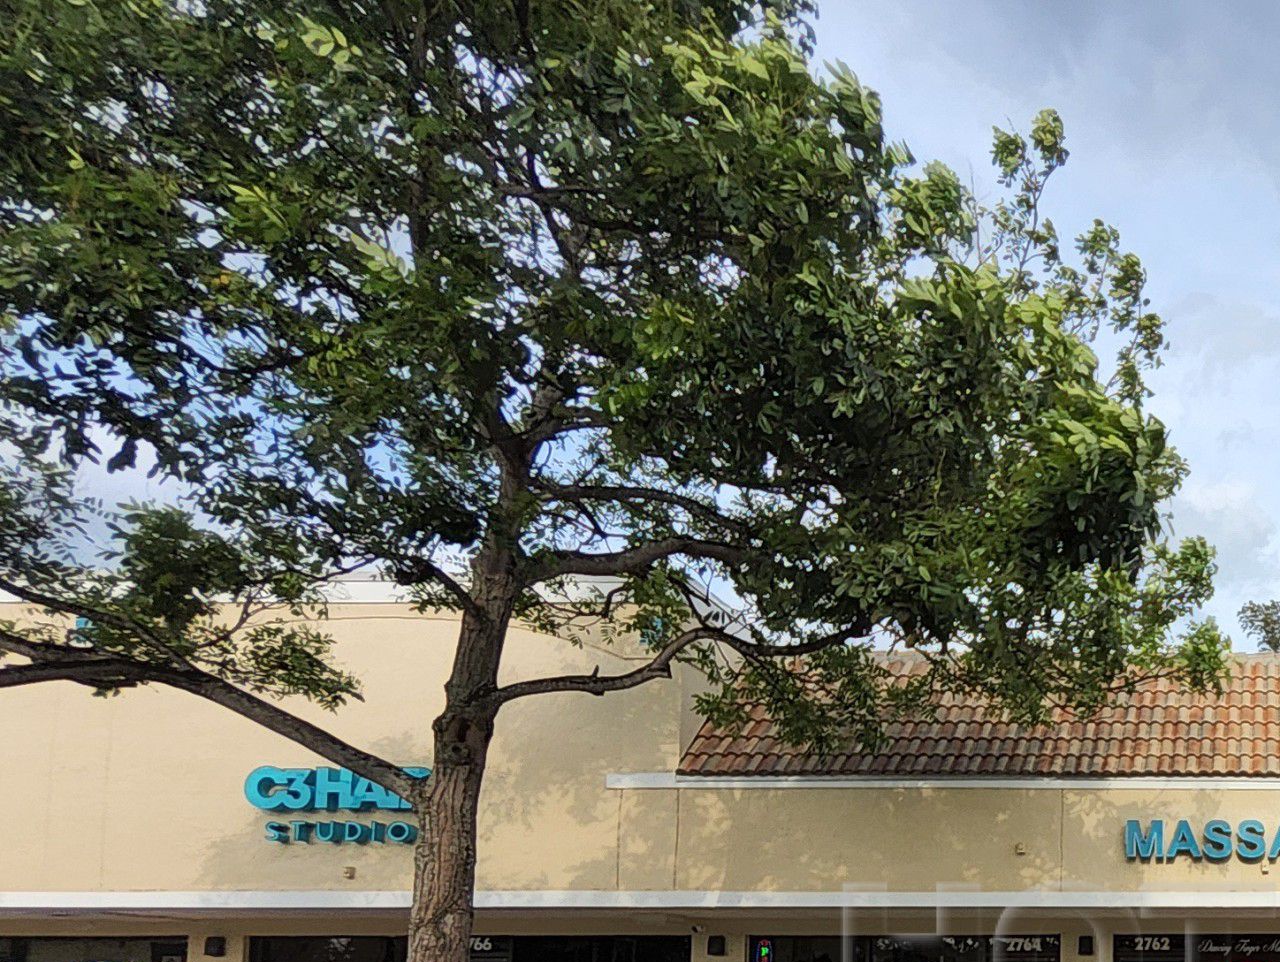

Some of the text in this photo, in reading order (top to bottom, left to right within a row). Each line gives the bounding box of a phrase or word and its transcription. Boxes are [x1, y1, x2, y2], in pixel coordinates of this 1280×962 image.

[265, 820, 413, 843] STUDIO
[1006, 939, 1042, 951] 2764
[1134, 937, 1170, 950] 2762
